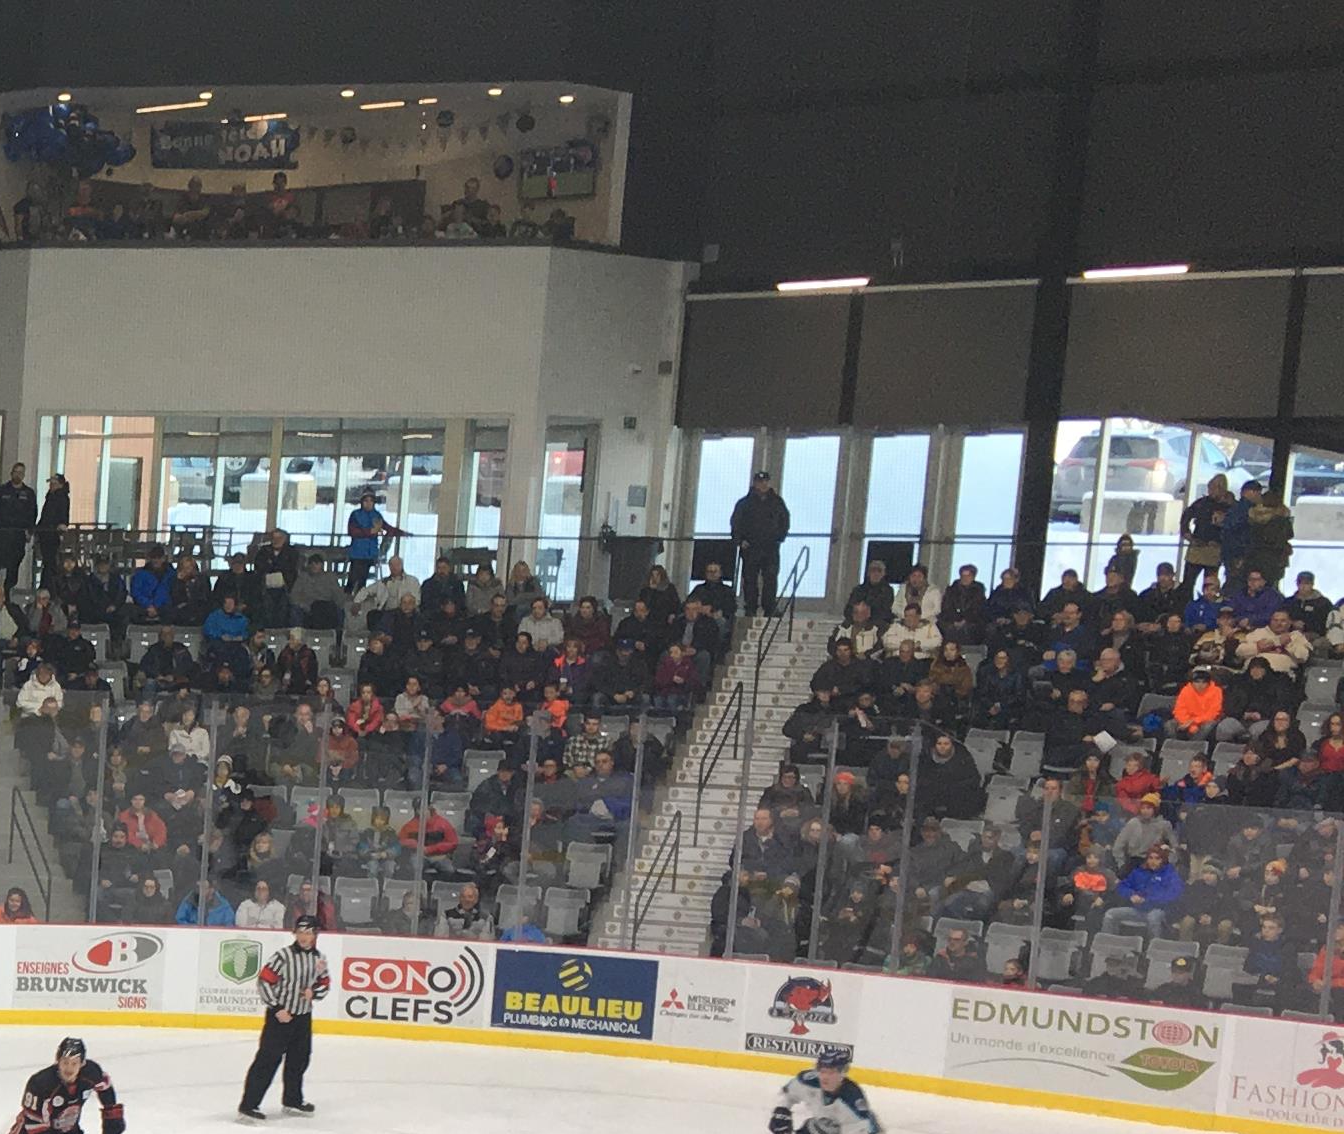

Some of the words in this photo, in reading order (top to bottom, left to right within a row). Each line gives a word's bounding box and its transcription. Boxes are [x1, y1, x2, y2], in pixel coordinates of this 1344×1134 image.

[17, 961, 70, 975] ENSEIGNES
[348, 961, 457, 993] SONO
[16, 976, 148, 994] BRUNSWICK
[117, 996, 147, 1010] SIGNS
[345, 995, 453, 1024] CLEFS
[505, 991, 643, 1021] BEAULIEU
[503, 1012, 558, 1027] PLUMBING
[571, 1018, 641, 1035] MECHANICAL
[952, 998, 1219, 1049] EDMUNDSTON
[950, 1031, 970, 1044] Un
[974, 1034, 1022, 1052] monde
[1027, 1038, 1116, 1062] d'excellence
[1141, 1055, 1199, 1073] TOYOTA
